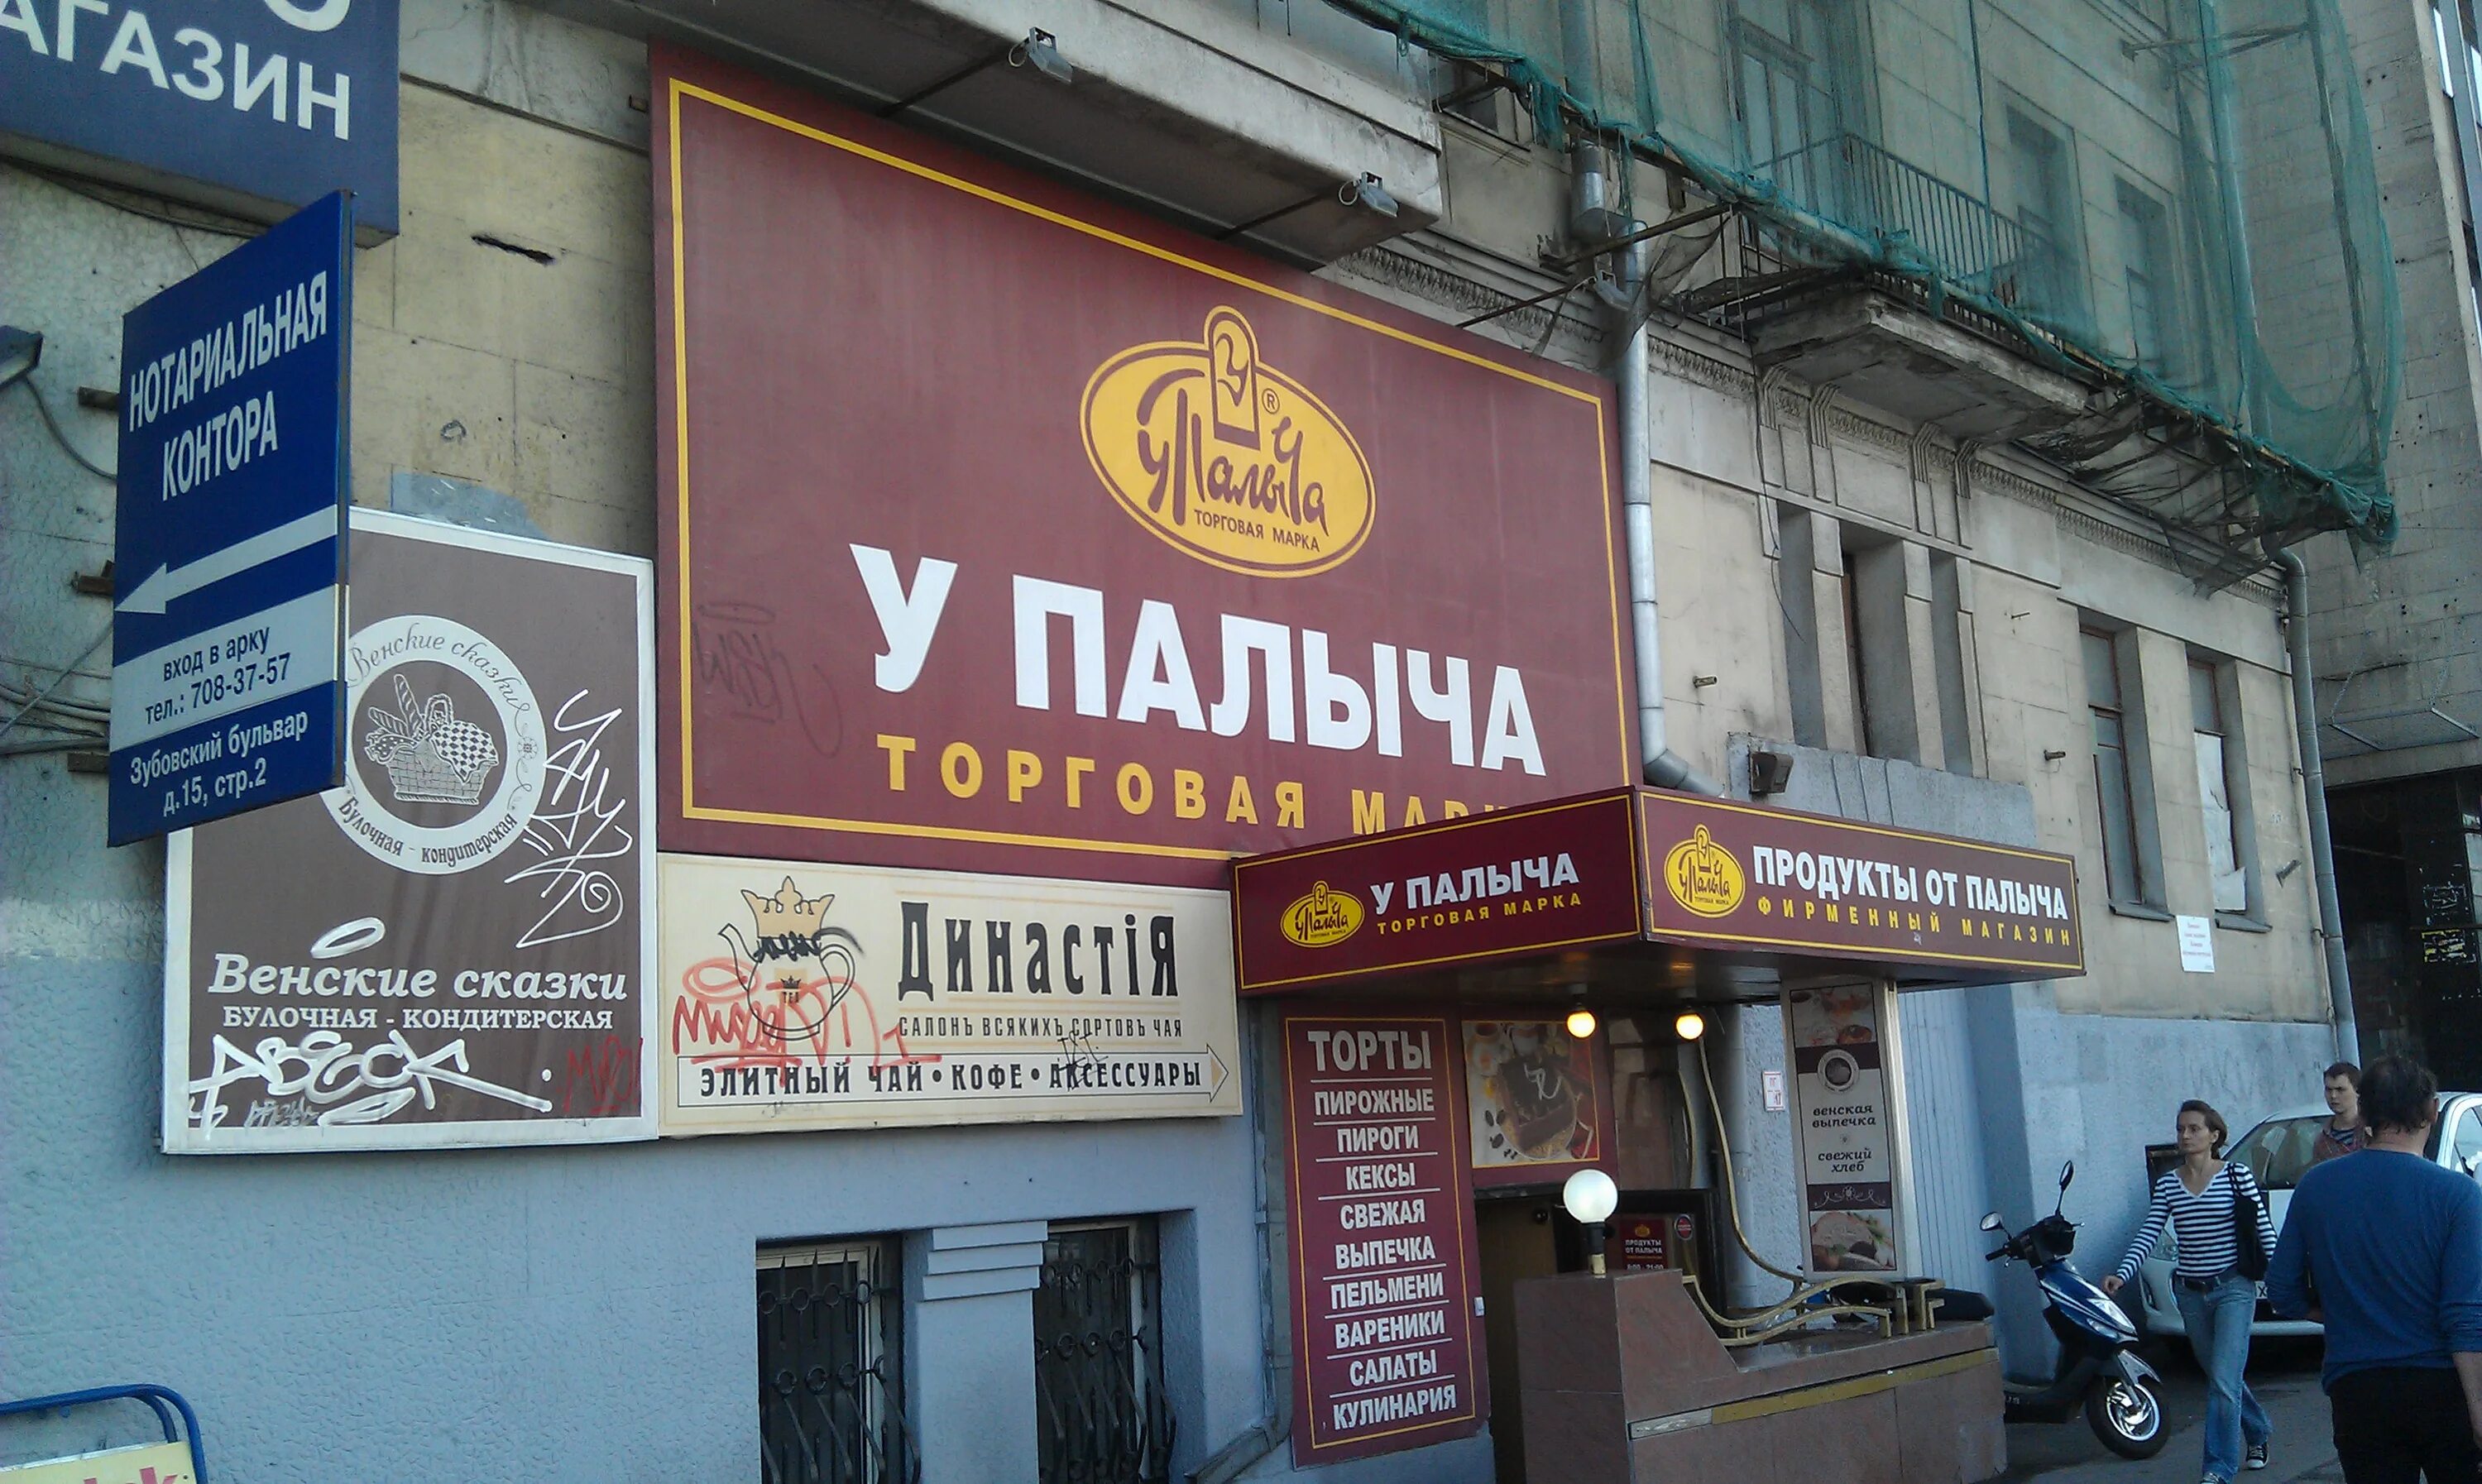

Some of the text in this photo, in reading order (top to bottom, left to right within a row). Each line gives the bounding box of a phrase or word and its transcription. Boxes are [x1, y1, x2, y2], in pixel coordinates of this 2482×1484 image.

[129, 270, 327, 433] НОТАРИАЛЬНАЯ
[162, 390, 278, 501] КОНТОРА
[1194, 509, 1321, 553] ТОРГОВАЯ МАРКА
[164, 627, 270, 682] вход в арку
[347, 622, 530, 720] Венские сказки
[850, 543, 958, 693] У
[1012, 573, 1546, 777] ПАЛЫЧА
[145, 652, 291, 725] тел.: 708-37-57
[130, 711, 309, 787] Зубовский бульвар
[164, 756, 267, 817] д.15, стр.2
[877, 734, 1306, 831] ТОРГОВАЯ
[338, 797, 404, 857] Булочная
[421, 812, 518, 868] кондитерская
[1369, 853, 1579, 916] У ПАЛЫЧА
[1752, 844, 2069, 922] ПРОДУКТЫ ОТ ПАЛЫЧА
[1377, 892, 1582, 936] ТОРГОВАЯ МАРКА
[1756, 898, 2071, 947] ФИРМЕННЫЙ МАГАЗИН
[208, 952, 628, 1001] Венские сказки
[223, 1006, 378, 1028] БУЛОЧНАЯ
[403, 1008, 614, 1032] КОНДИТЕРСКАЯ
[898, 1016, 1182, 1037] САЛОНЪ ВСЯКИХЪ СОРТОВЪ ЧАЯ
[1308, 1030, 1432, 1073] ТОРТЫ
[701, 1061, 1201, 1098] ЭЛИТНЫЙ ЧАЙ КОФЕ АКСЕССУАРЫ
[1314, 1088, 1435, 1117] ПИРОЖНЫЕ
[1812, 1116, 1876, 1128] выпечка
[1813, 1104, 1874, 1116] венская
[1337, 1125, 1420, 1153] ПИРОГИ
[1818, 1147, 1872, 1161] свежий
[1345, 1162, 1416, 1191] КЕКСЫ
[1831, 1161, 1866, 1173] хлеб
[1339, 1199, 1426, 1231] СВЕЖАЯ
[1334, 1234, 1436, 1271] ВЫПЕЧКА
[1330, 1272, 1445, 1310] ПЕЛЬМЕНИ
[1334, 1309, 1446, 1350] ВАРЕНИКИ
[1349, 1349, 1437, 1388] САЛАТЫ
[1333, 1384, 1457, 1432] КУЛИНАРИЯ
